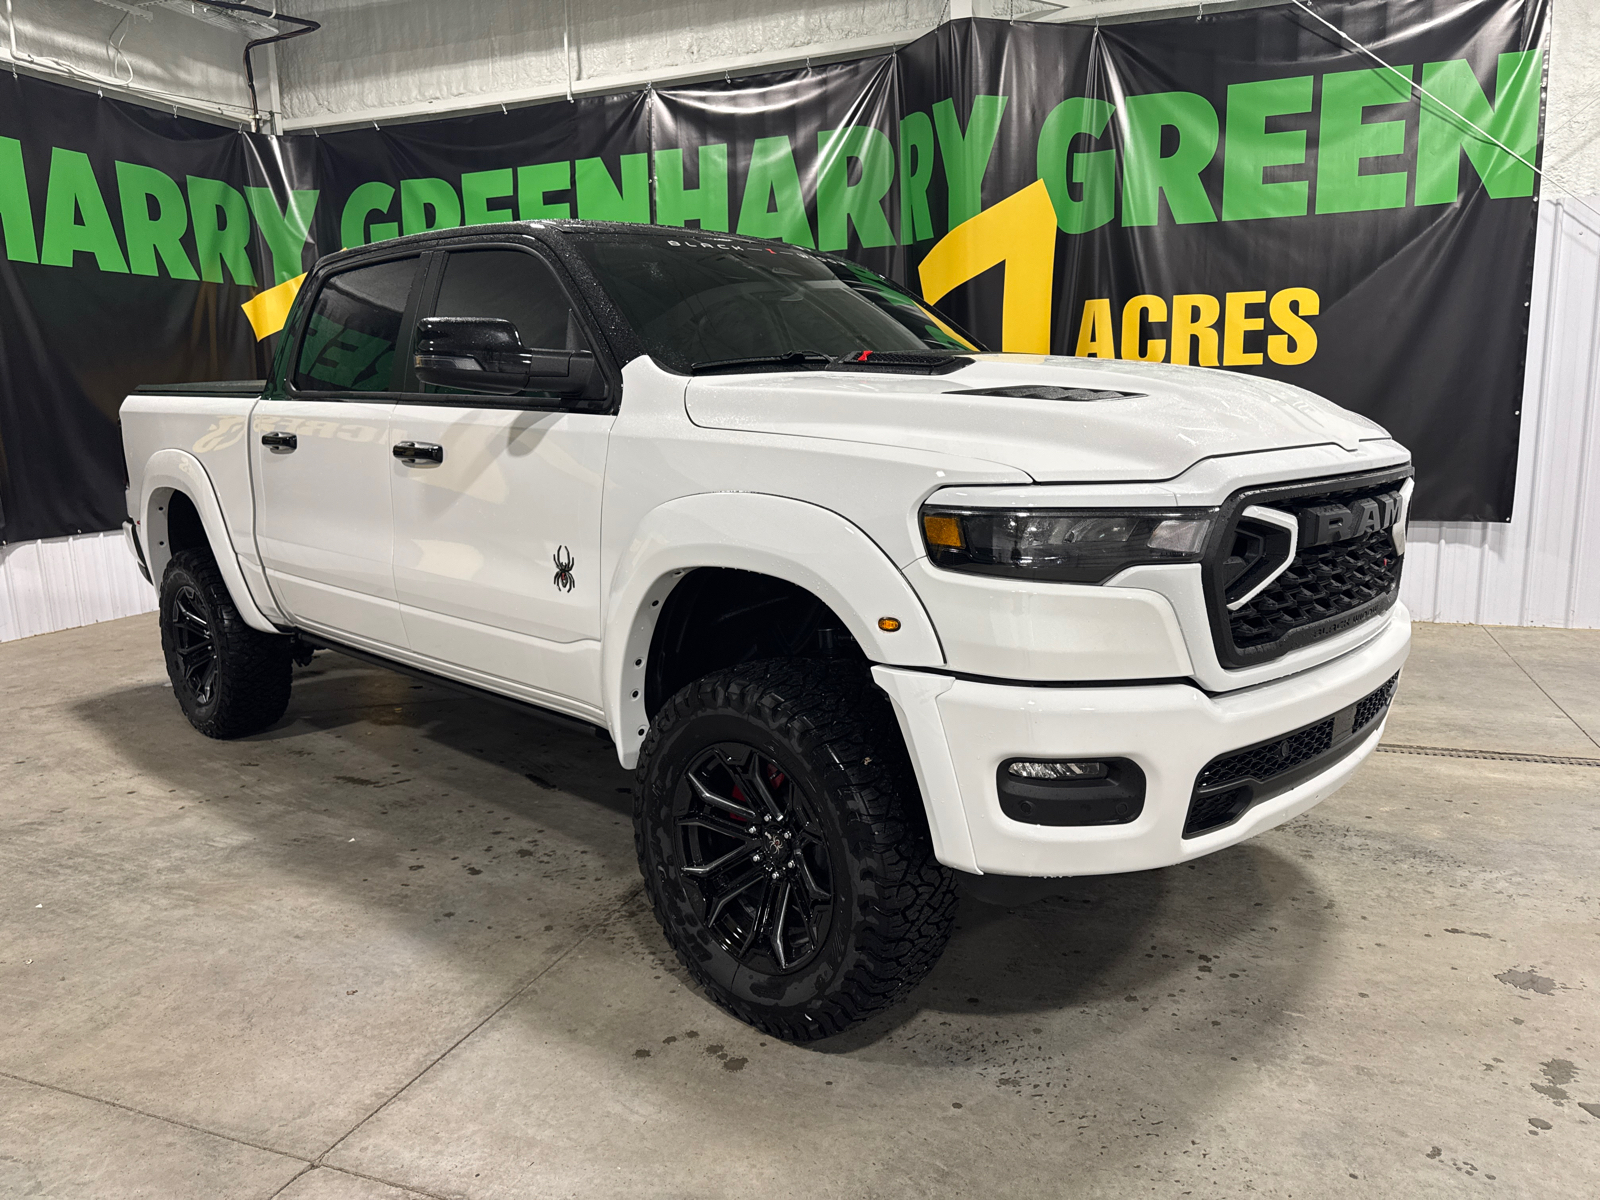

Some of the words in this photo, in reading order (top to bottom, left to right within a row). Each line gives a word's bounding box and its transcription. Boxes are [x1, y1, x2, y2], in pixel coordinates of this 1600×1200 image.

[655, 94, 1009, 252] HARRY
[1036, 49, 1543, 236] GREEN
[341, 152, 649, 249] GREEN
[666, 239, 745, 252] BLACK
[1076, 287, 1320, 367] ACRES
[1303, 491, 1403, 546] RAM
[1312, 618, 1351, 638] BLACK
